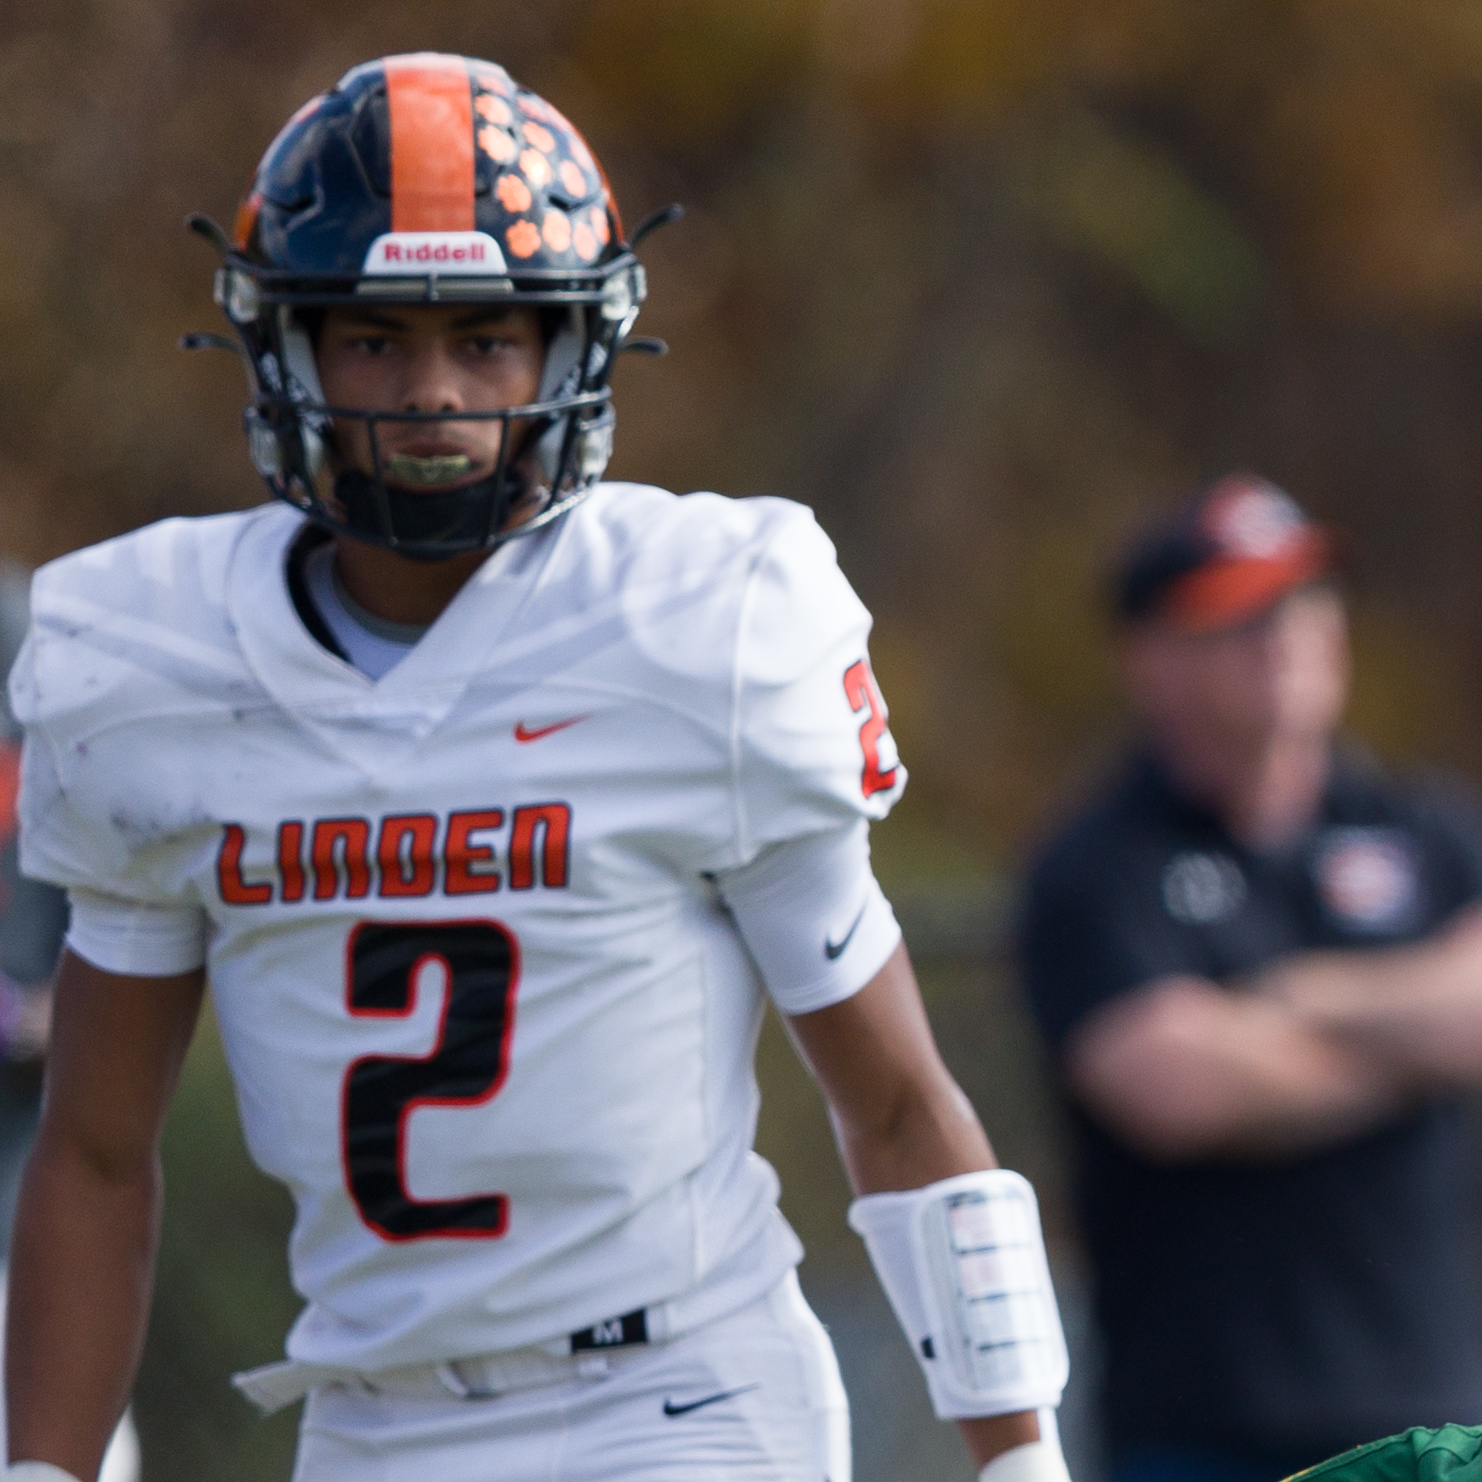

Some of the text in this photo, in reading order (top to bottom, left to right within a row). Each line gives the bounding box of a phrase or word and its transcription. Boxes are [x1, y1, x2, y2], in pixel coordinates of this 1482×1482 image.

[385, 242, 486, 261] Riddell
[843, 658, 899, 799] 2
[217, 801, 572, 906] LINDEN
[338, 919, 521, 1244] 2
